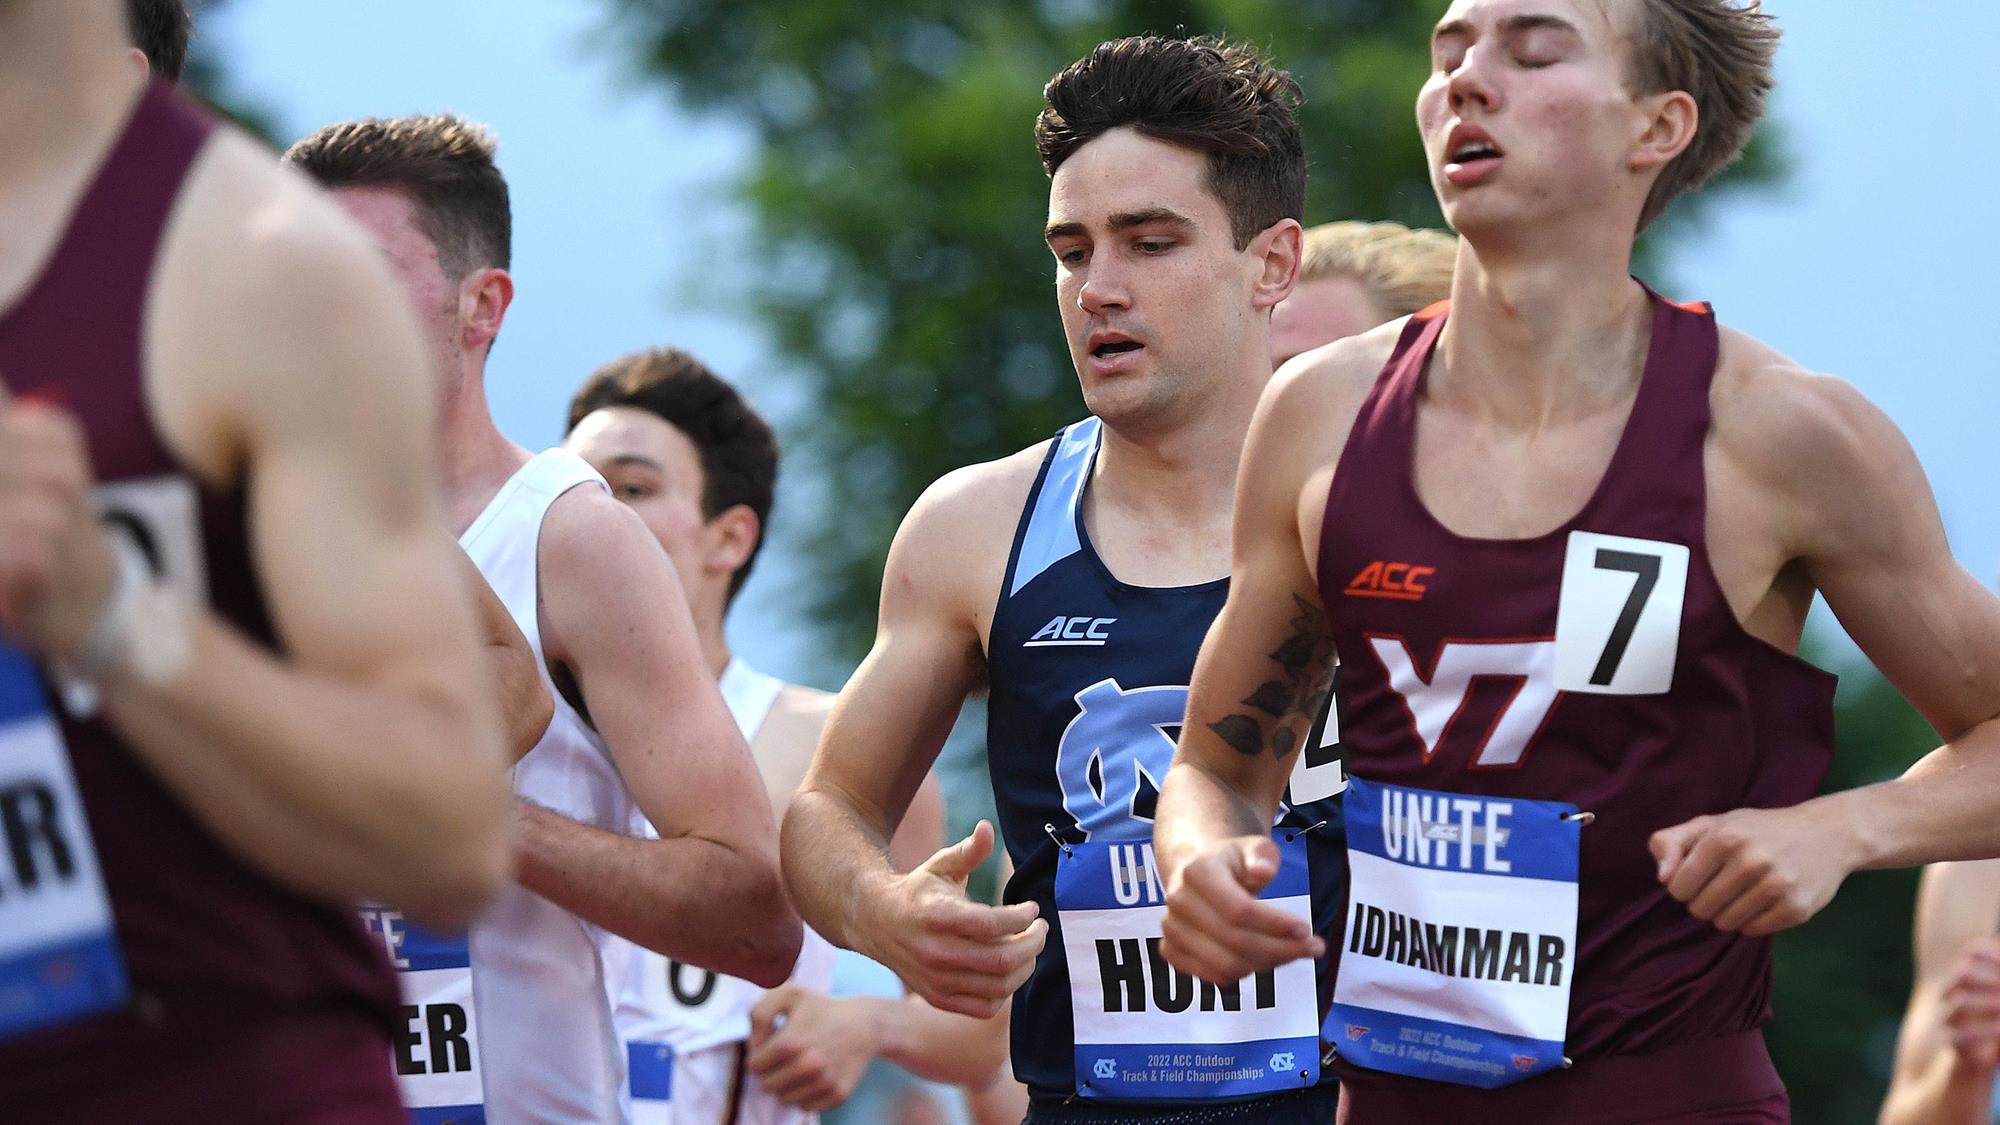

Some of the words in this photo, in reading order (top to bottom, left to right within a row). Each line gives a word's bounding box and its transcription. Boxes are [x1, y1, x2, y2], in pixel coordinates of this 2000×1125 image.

[1349, 560, 1437, 593] ACC
[1030, 615, 1118, 640] ACC
[1589, 547, 1662, 686] 7
[1382, 788, 1513, 873] UNITE
[1350, 902, 1565, 987] IDHAMMAR
[1122, 1070, 1148, 1082] Track
[1150, 1069, 1158, 1082] &
[1159, 1069, 1185, 1082] Field
[1186, 1067, 1264, 1084] Championships
[1147, 1054, 1171, 1067] 2022
[1172, 1054, 1193, 1067] ACC
[1195, 1054, 1236, 1067] Outdoor
